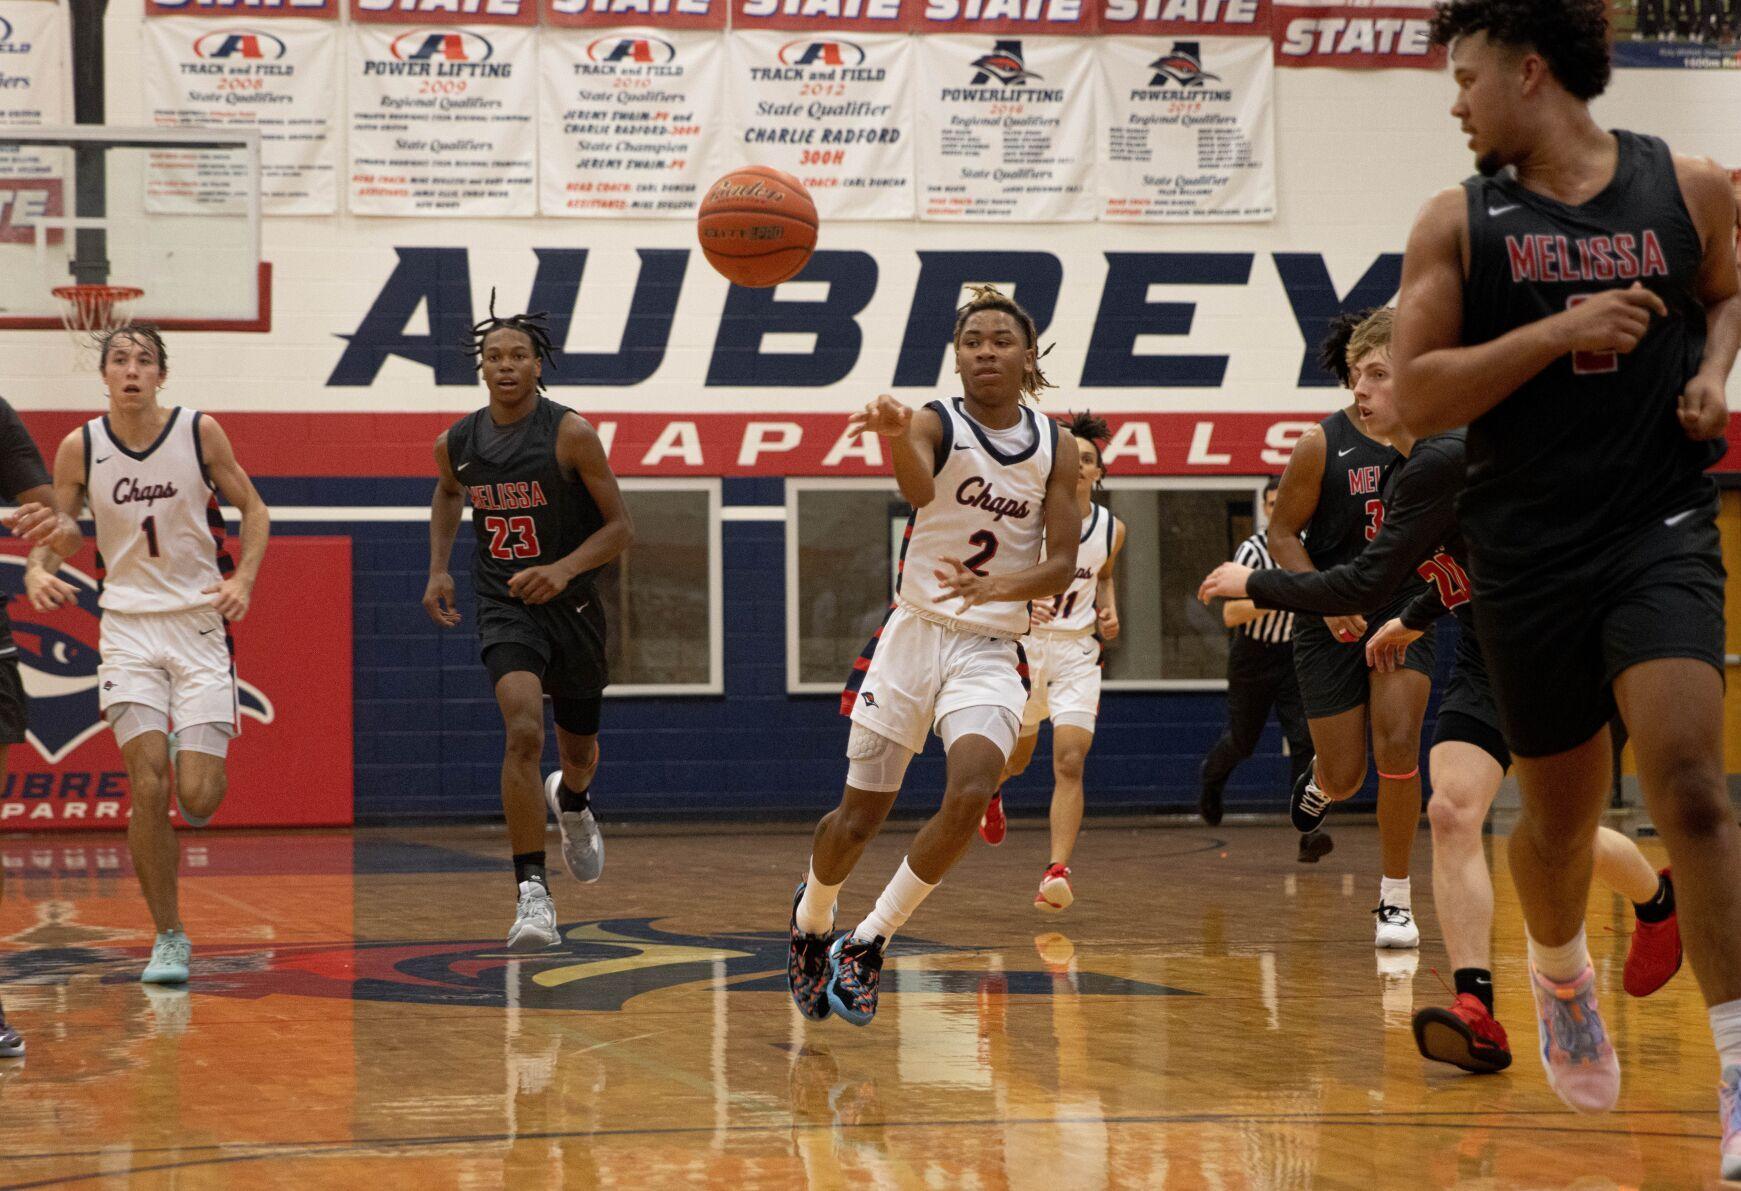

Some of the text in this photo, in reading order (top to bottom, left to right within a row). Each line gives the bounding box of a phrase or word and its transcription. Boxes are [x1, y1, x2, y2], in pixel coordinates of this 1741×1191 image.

[1280, 17, 1431, 56] STATE
[180, 63, 294, 76] TRACK and FIELD
[363, 61, 512, 77] POWER LIFTING
[573, 64, 684, 77] TRACK and FIELD
[751, 68, 886, 81] TRACK and FIELD
[419, 80, 468, 94] 2009
[800, 83, 846, 96] 2012
[188, 90, 294, 105] State Qualifiers
[579, 90, 686, 105] State Qualifiers
[941, 88, 1064, 103] POWERLIFTING
[1130, 89, 1232, 101] POWERLIFTING
[380, 95, 502, 111] Regional Qualifiers
[756, 100, 891, 120] State Qualifier
[951, 115, 1060, 128] Regional Qualifiers
[745, 128, 900, 144] CHARLIE RADFORD
[394, 139, 493, 153] State Qualifiers
[577, 140, 688, 155] State Champion
[800, 150, 845, 165] 300H
[961, 168, 1053, 182] State Qualifiers
[1505, 230, 1669, 283] MELISSA
[325, 247, 1408, 388] AUBREY
[113, 477, 178, 507] Chaps
[465, 481, 548, 511] MELISSA
[955, 476, 1030, 522] Chaps
[142, 515, 160, 558] 1
[485, 515, 541, 560] 23
[963, 529, 999, 577] 2
